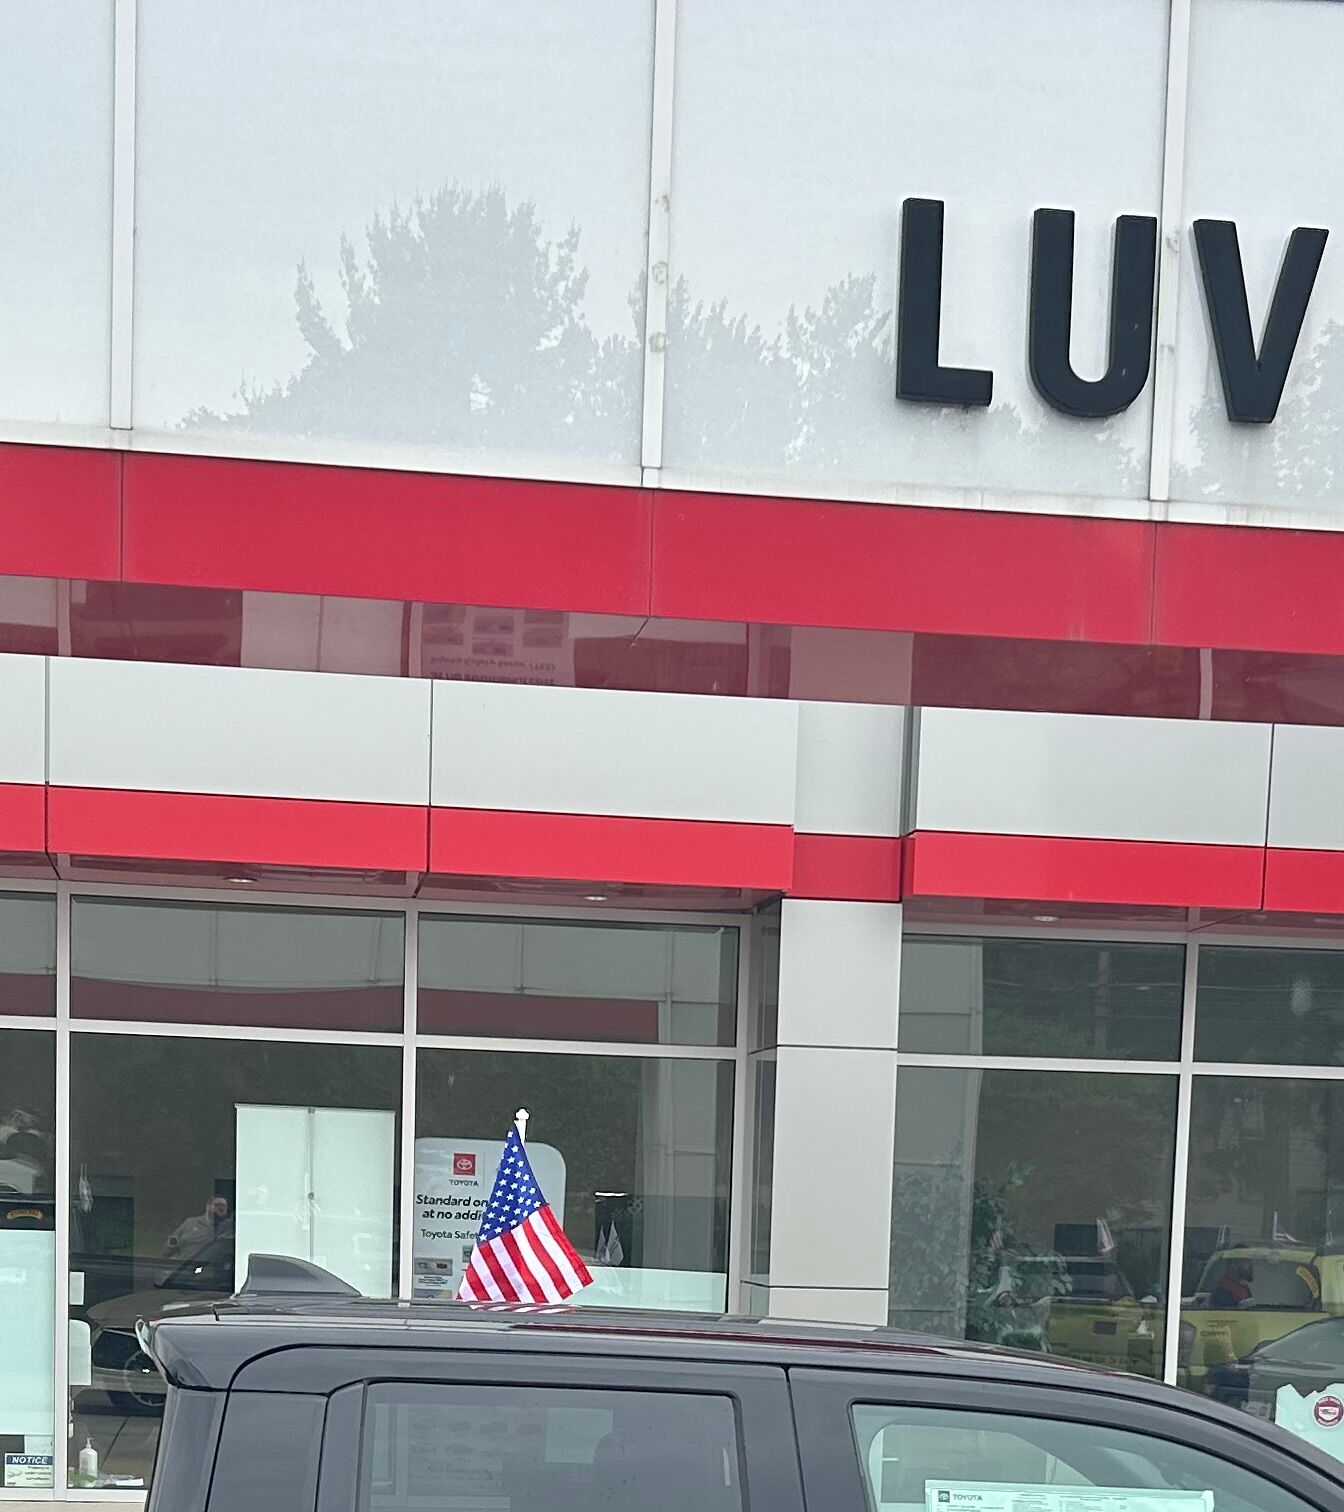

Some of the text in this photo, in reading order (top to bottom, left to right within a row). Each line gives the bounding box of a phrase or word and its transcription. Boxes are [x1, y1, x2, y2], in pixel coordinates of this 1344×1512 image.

[895, 197, 1329, 424] LUV
[449, 1179, 479, 1187] TOYOTA
[416, 1194, 471, 1207] Standard
[422, 1210, 483, 1221] at no addi
[421, 1229, 478, 1240] Toyota Safet
[12, 1456, 48, 1465] NOTICE
[953, 1493, 983, 1501] TOYOTA
